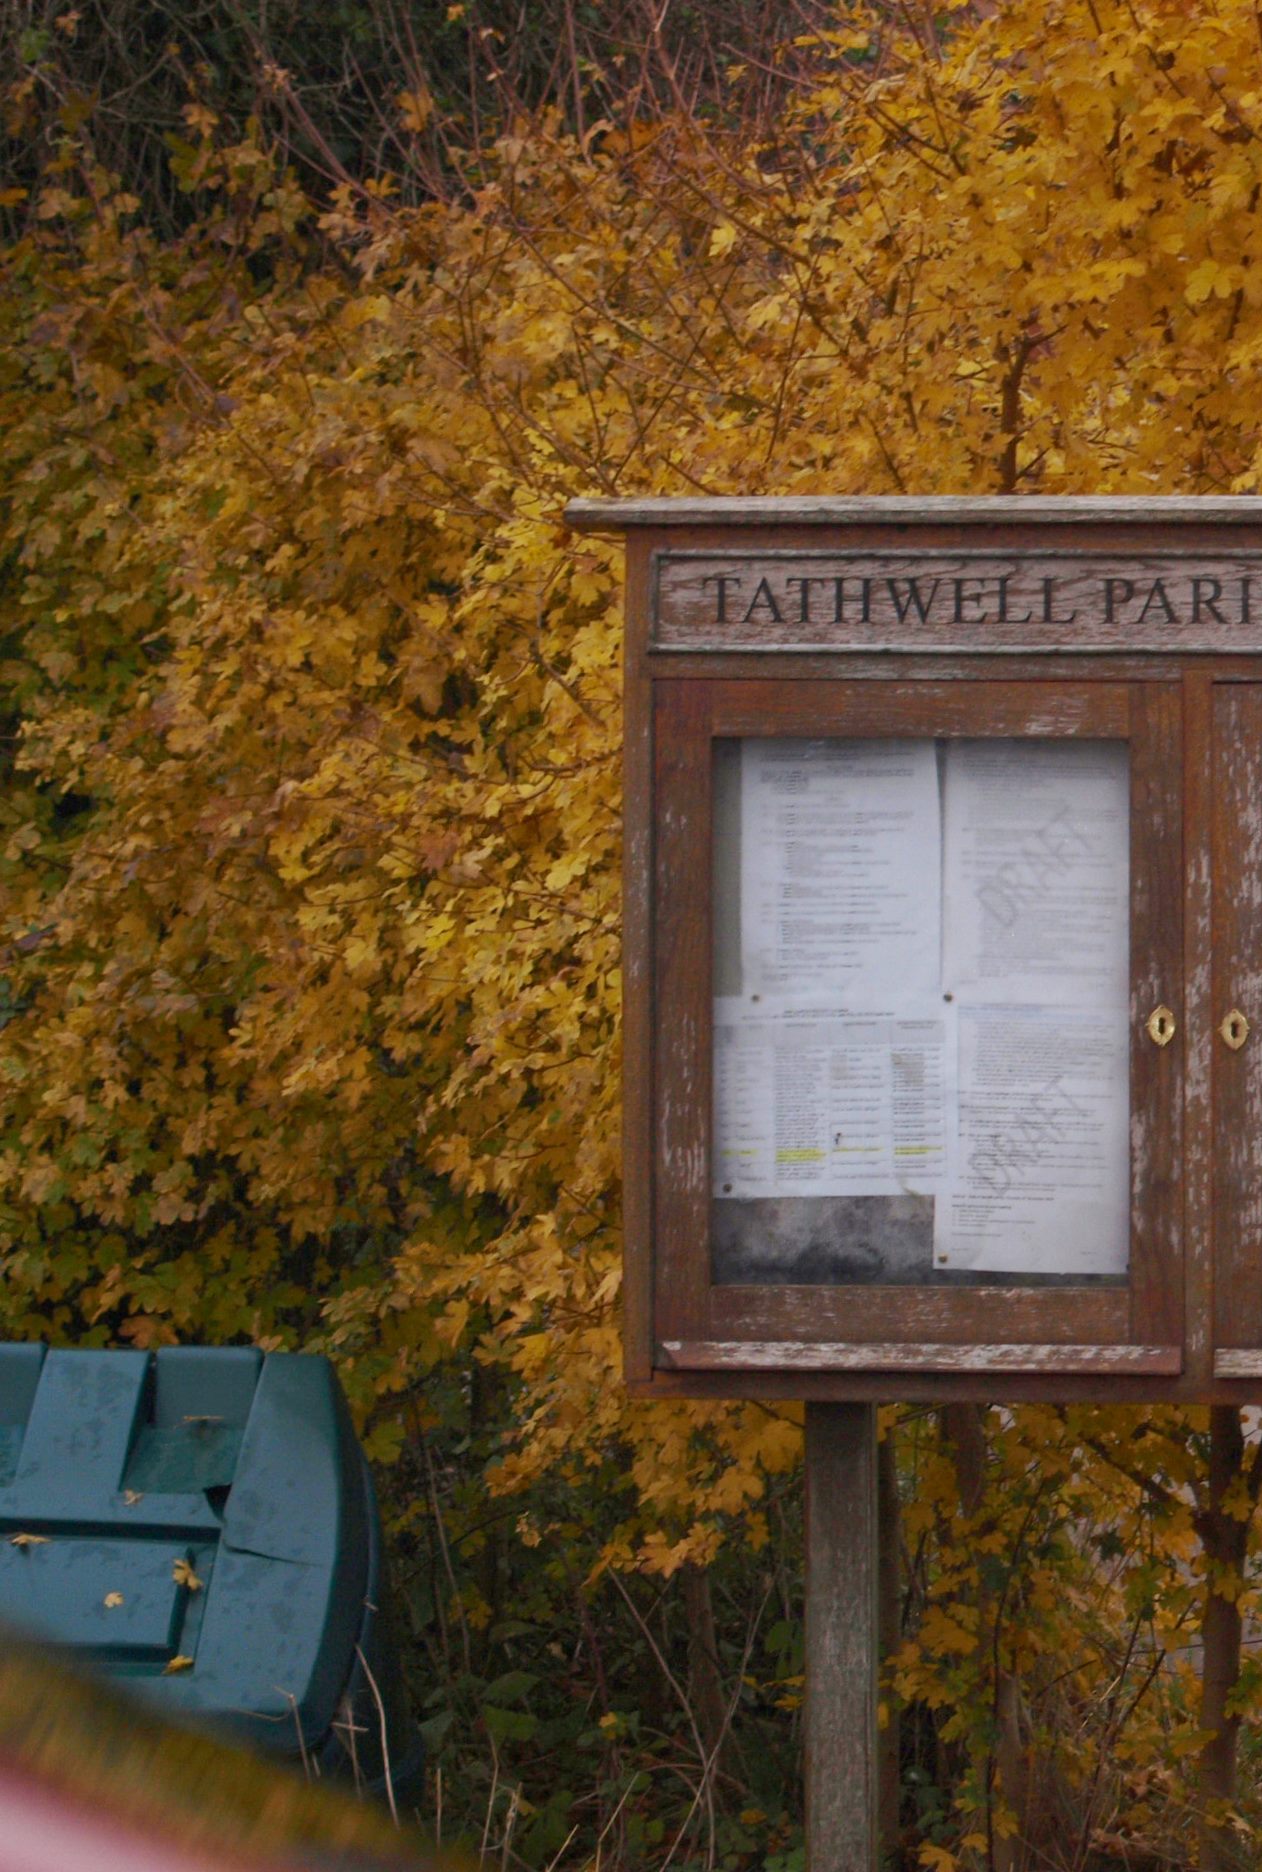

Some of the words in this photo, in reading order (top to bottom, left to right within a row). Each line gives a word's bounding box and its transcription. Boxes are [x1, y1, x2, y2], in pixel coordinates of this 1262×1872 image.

[702, 575, 1078, 627] TATHWELL
[976, 804, 1094, 928] DRAFT
[968, 1074, 1083, 1196] DRAFT
